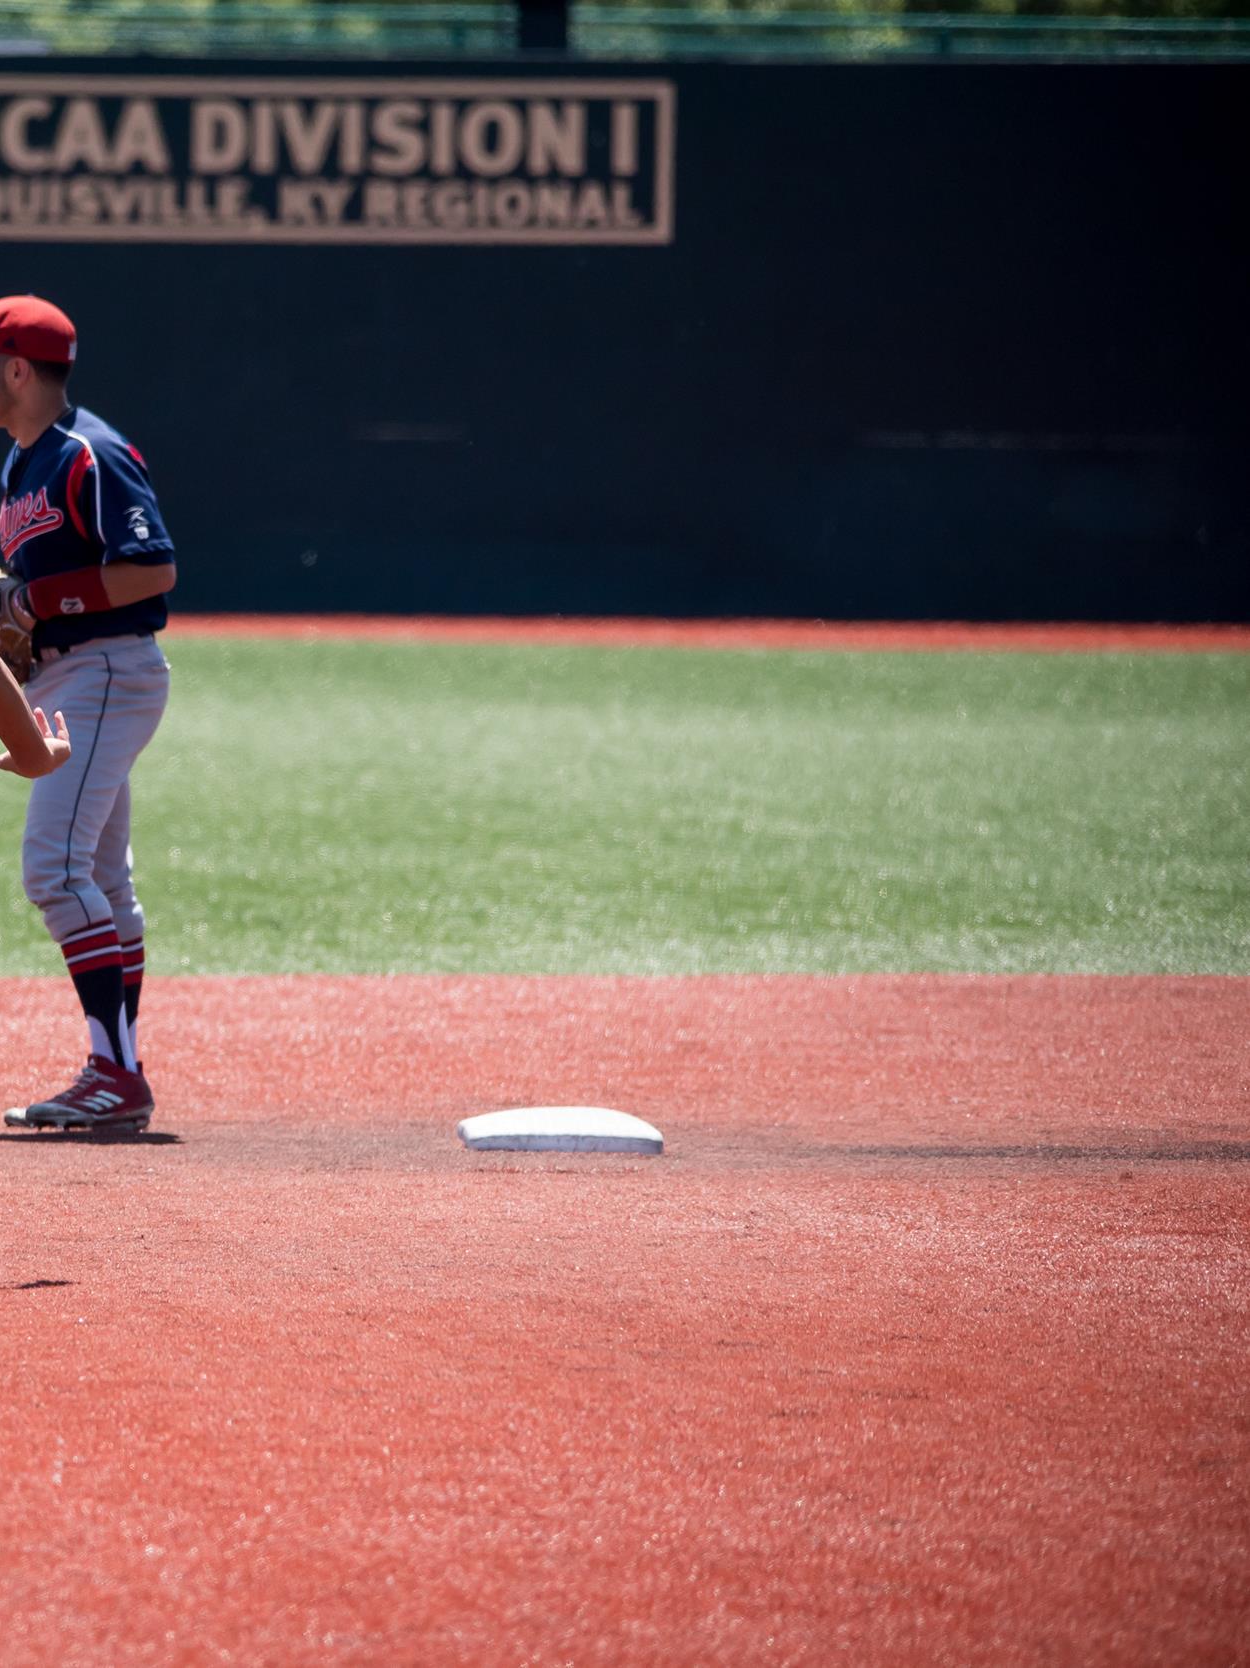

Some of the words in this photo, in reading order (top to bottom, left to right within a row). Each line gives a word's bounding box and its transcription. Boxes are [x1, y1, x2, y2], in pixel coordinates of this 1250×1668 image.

[190, 97, 586, 178] DIVISION
[611, 101, 637, 178] I
[277, 178, 351, 227] KY
[363, 178, 645, 229] REGIONAL
